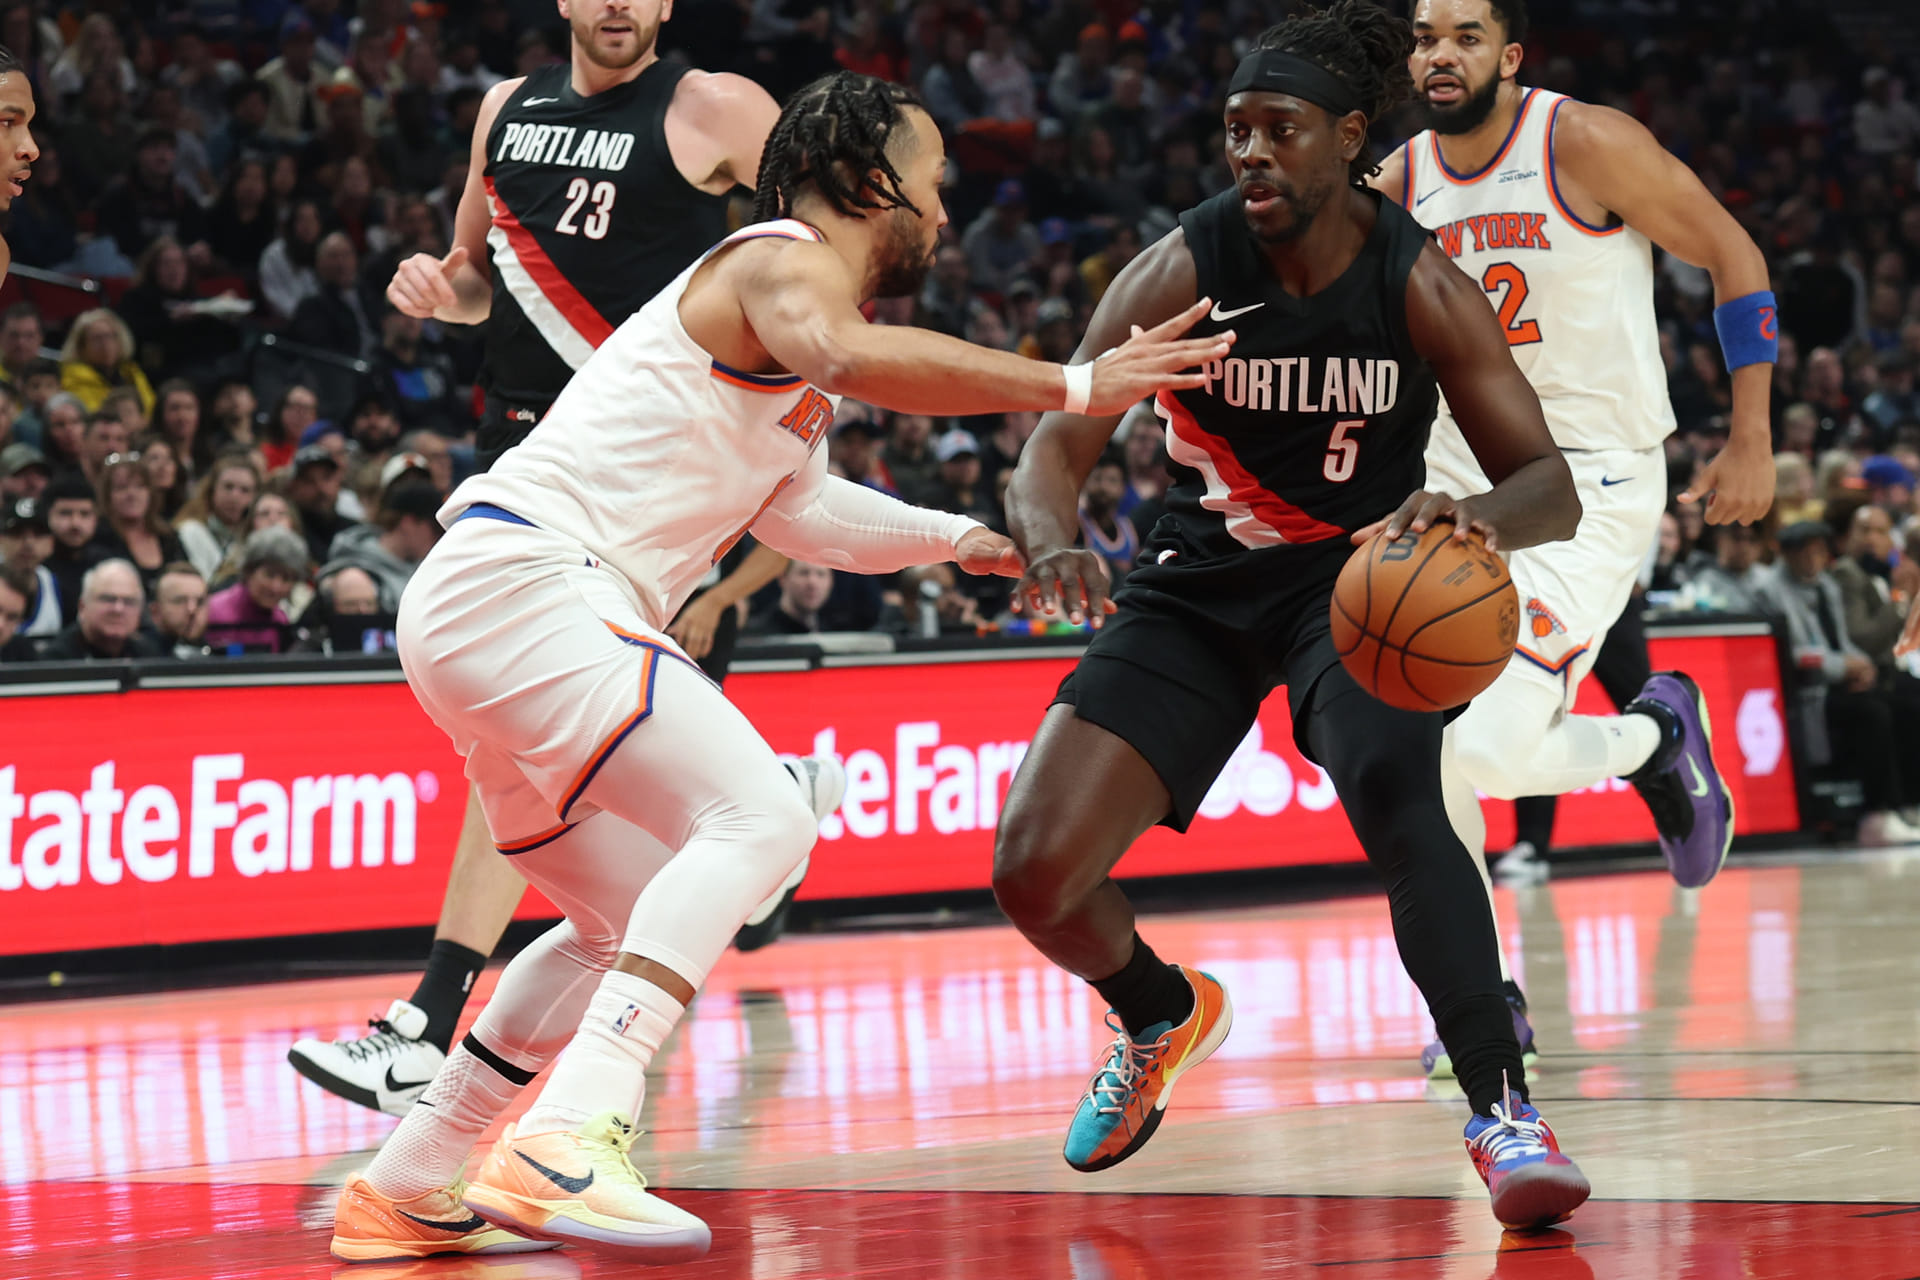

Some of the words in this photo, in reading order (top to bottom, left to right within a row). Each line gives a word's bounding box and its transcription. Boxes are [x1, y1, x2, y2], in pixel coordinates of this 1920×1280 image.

[496, 122, 635, 171] PORTLAND
[555, 177, 616, 240] 23
[1467, 212, 1552, 253] YORK
[1482, 262, 1543, 346] 2
[1201, 357, 1399, 415] PORTLAND
[1322, 420, 1366, 483] 5
